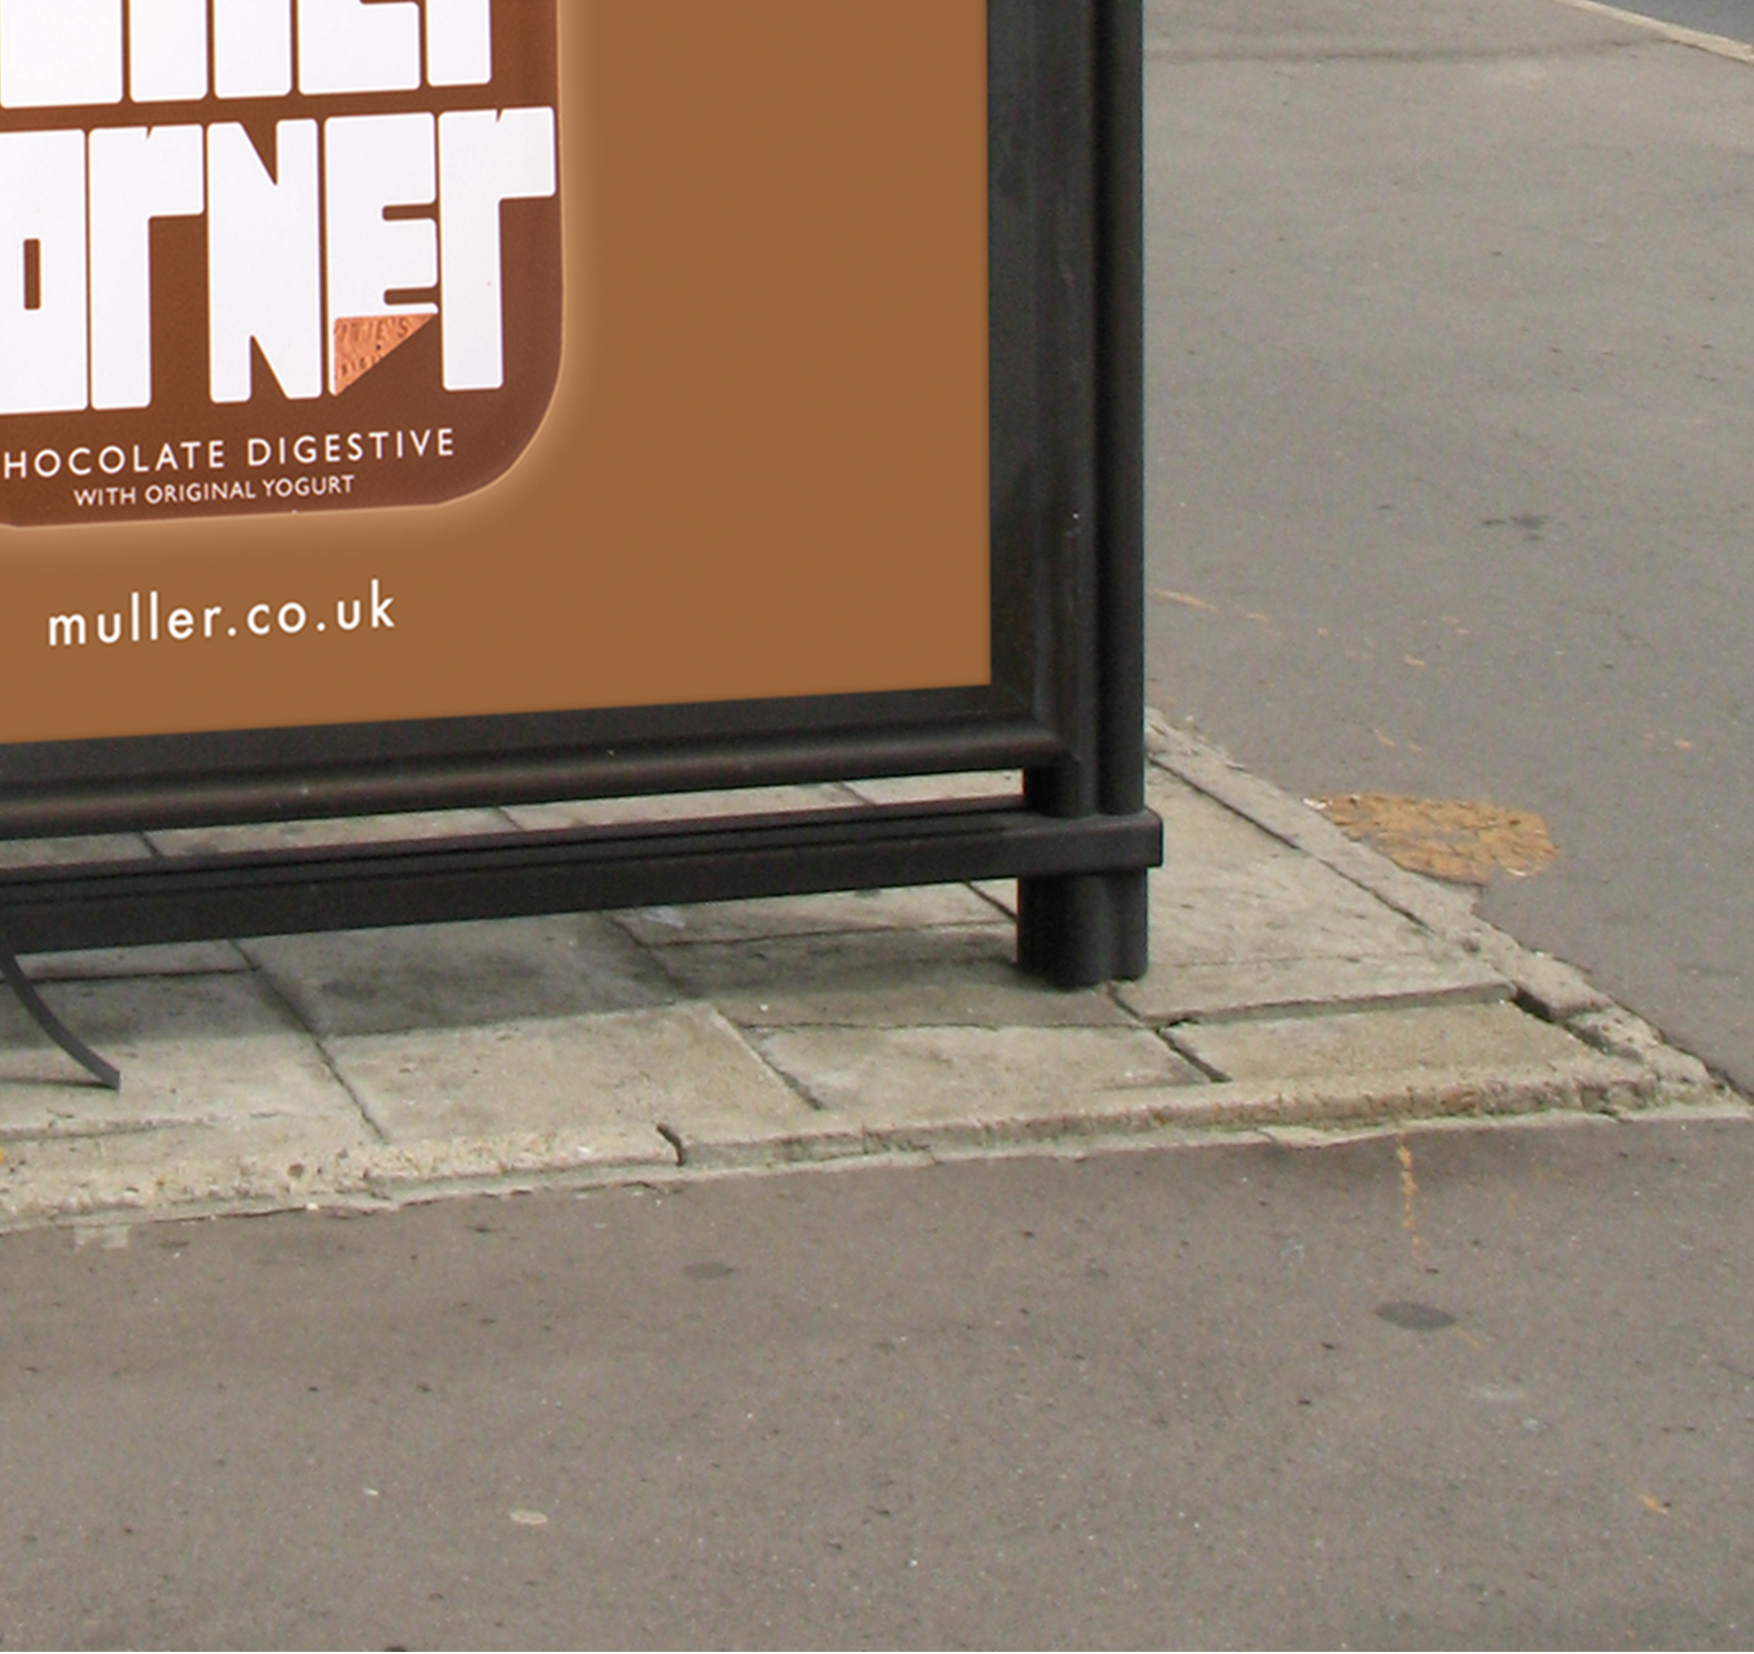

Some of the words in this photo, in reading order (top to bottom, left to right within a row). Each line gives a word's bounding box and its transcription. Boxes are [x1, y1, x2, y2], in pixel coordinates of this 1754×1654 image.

[248, 427, 456, 466] DIGESTIVE
[73, 484, 137, 507] WITH
[144, 479, 256, 504] ORIGINAL
[262, 473, 355, 499] YOGURT
[47, 578, 396, 646] muller.co.uk
